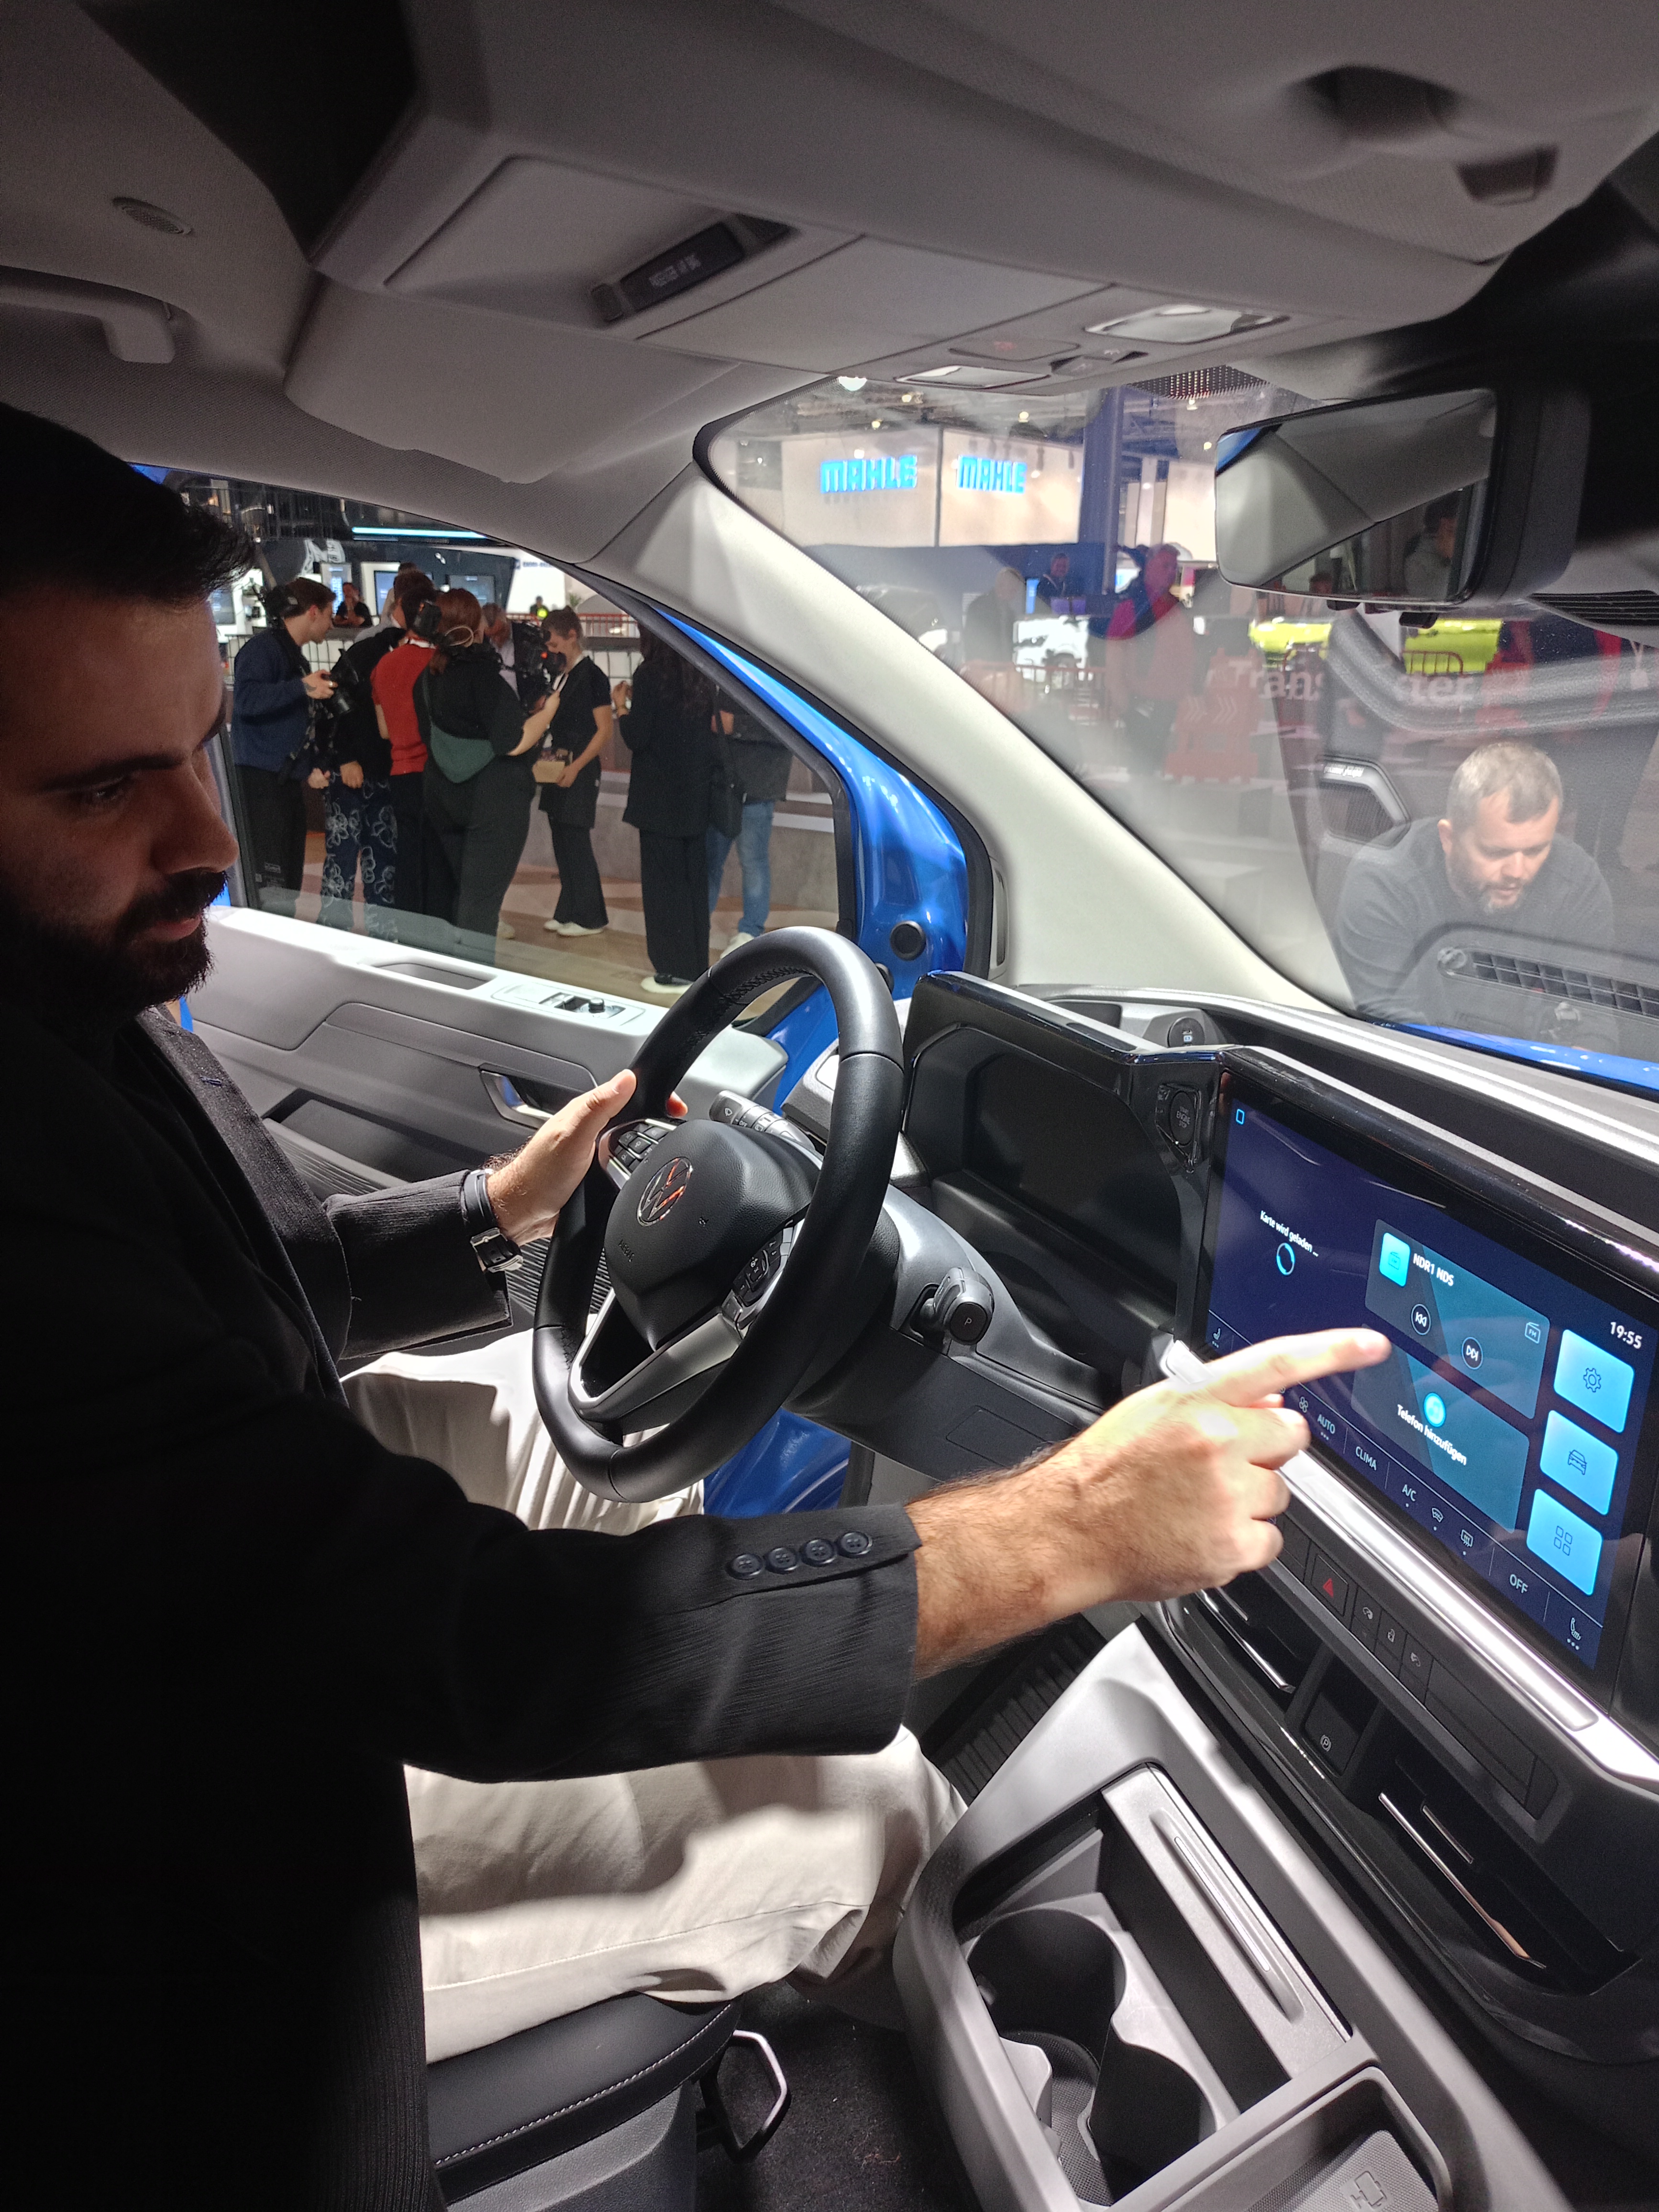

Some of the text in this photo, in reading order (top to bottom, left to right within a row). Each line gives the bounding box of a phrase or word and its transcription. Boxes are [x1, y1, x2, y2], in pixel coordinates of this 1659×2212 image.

[820, 454, 917, 493] MAHLE
[957, 455, 1027, 495] MAHLE
[1176, 1110, 1191, 1125] ENGINE
[1261, 1210, 1275, 1228] Karte
[1276, 1223, 1289, 1237] wird
[1289, 1232, 1313, 1252] geladen
[1413, 1253, 1454, 1286] NDR1 NDS
[964, 1317, 973, 1326] P
[1529, 1329, 1537, 1338] FM
[1610, 1322, 1643, 1349] 19:55
[1317, 1414, 1335, 1434] AUTO
[1397, 1404, 1467, 1465] Telefon hinzufügen
[1356, 1446, 1377, 1471] CLIMA
[1402, 1484, 1416, 1502] A/C
[1510, 1574, 1528, 1593] OFF
